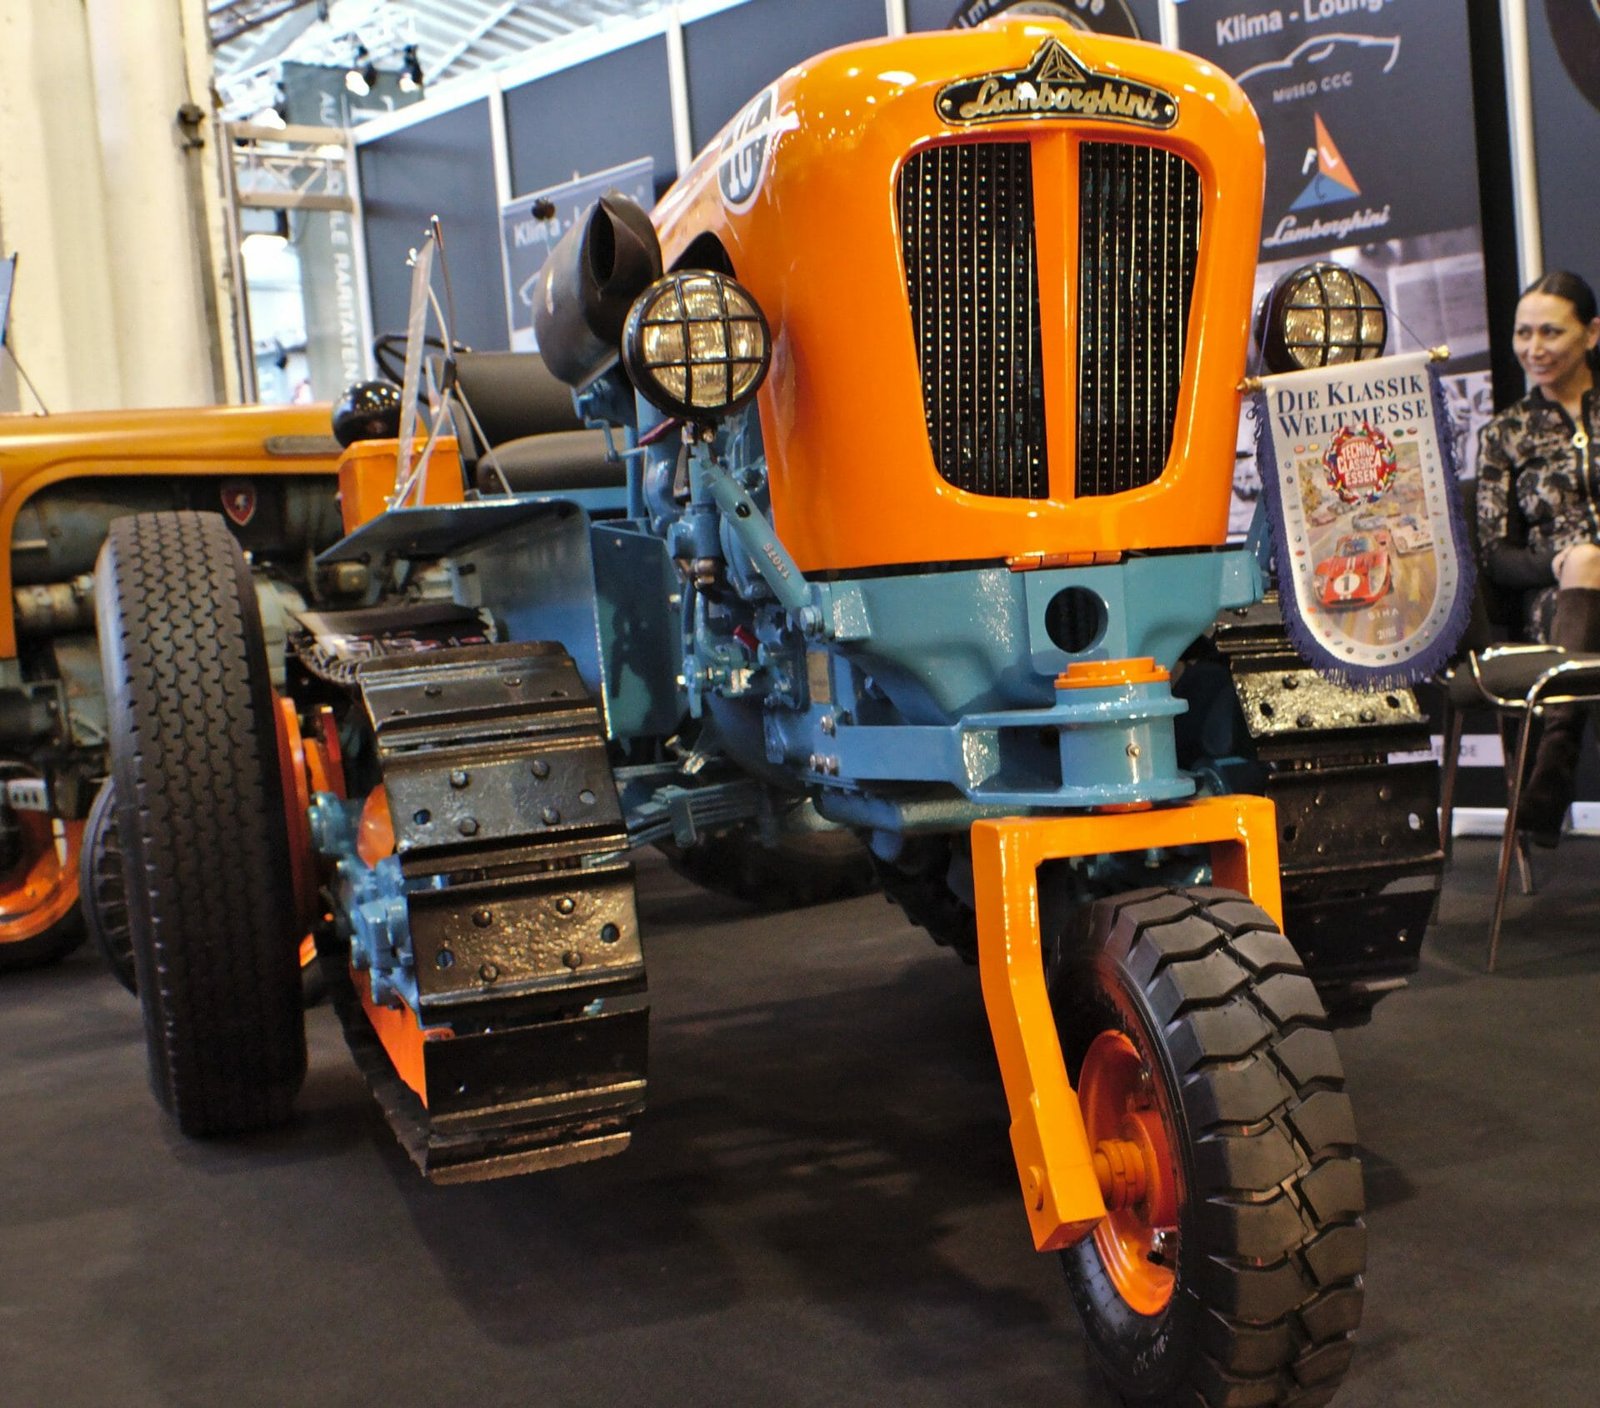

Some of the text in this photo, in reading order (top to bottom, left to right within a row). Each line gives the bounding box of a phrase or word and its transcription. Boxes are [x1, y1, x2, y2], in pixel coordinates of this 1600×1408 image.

[1215, 10, 1284, 46] Klima
[1320, 70, 1353, 92] CCC
[960, 79, 1159, 120] Lamborghini
[1262, 203, 1391, 248] Lamborghini
[1277, 374, 1424, 414] DIE KLASSIK
[1278, 399, 1429, 438] WELTMESSE
[1336, 450, 1382, 474] CLASSICA
[1341, 441, 1376, 461] TECHNO
[1345, 469, 1378, 486] ESSEN
